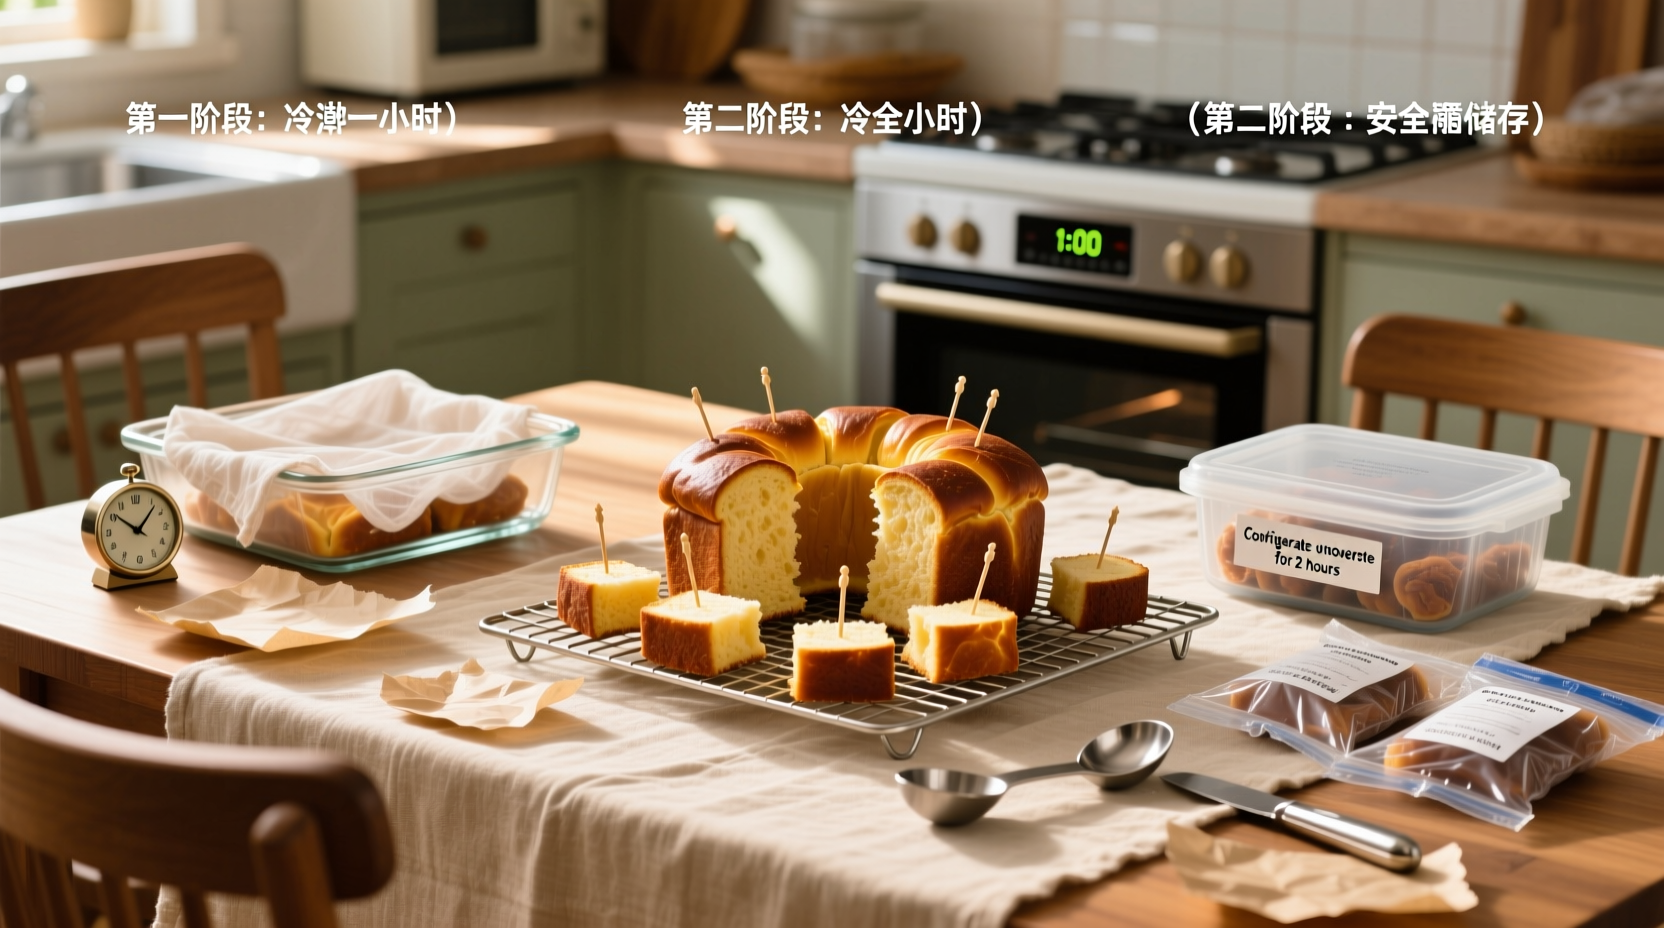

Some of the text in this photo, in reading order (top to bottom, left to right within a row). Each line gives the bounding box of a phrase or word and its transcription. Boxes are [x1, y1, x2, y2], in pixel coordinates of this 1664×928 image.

[1055, 227, 1102, 257] 1:00
[1275, 551, 1340, 576] for 2 hours
